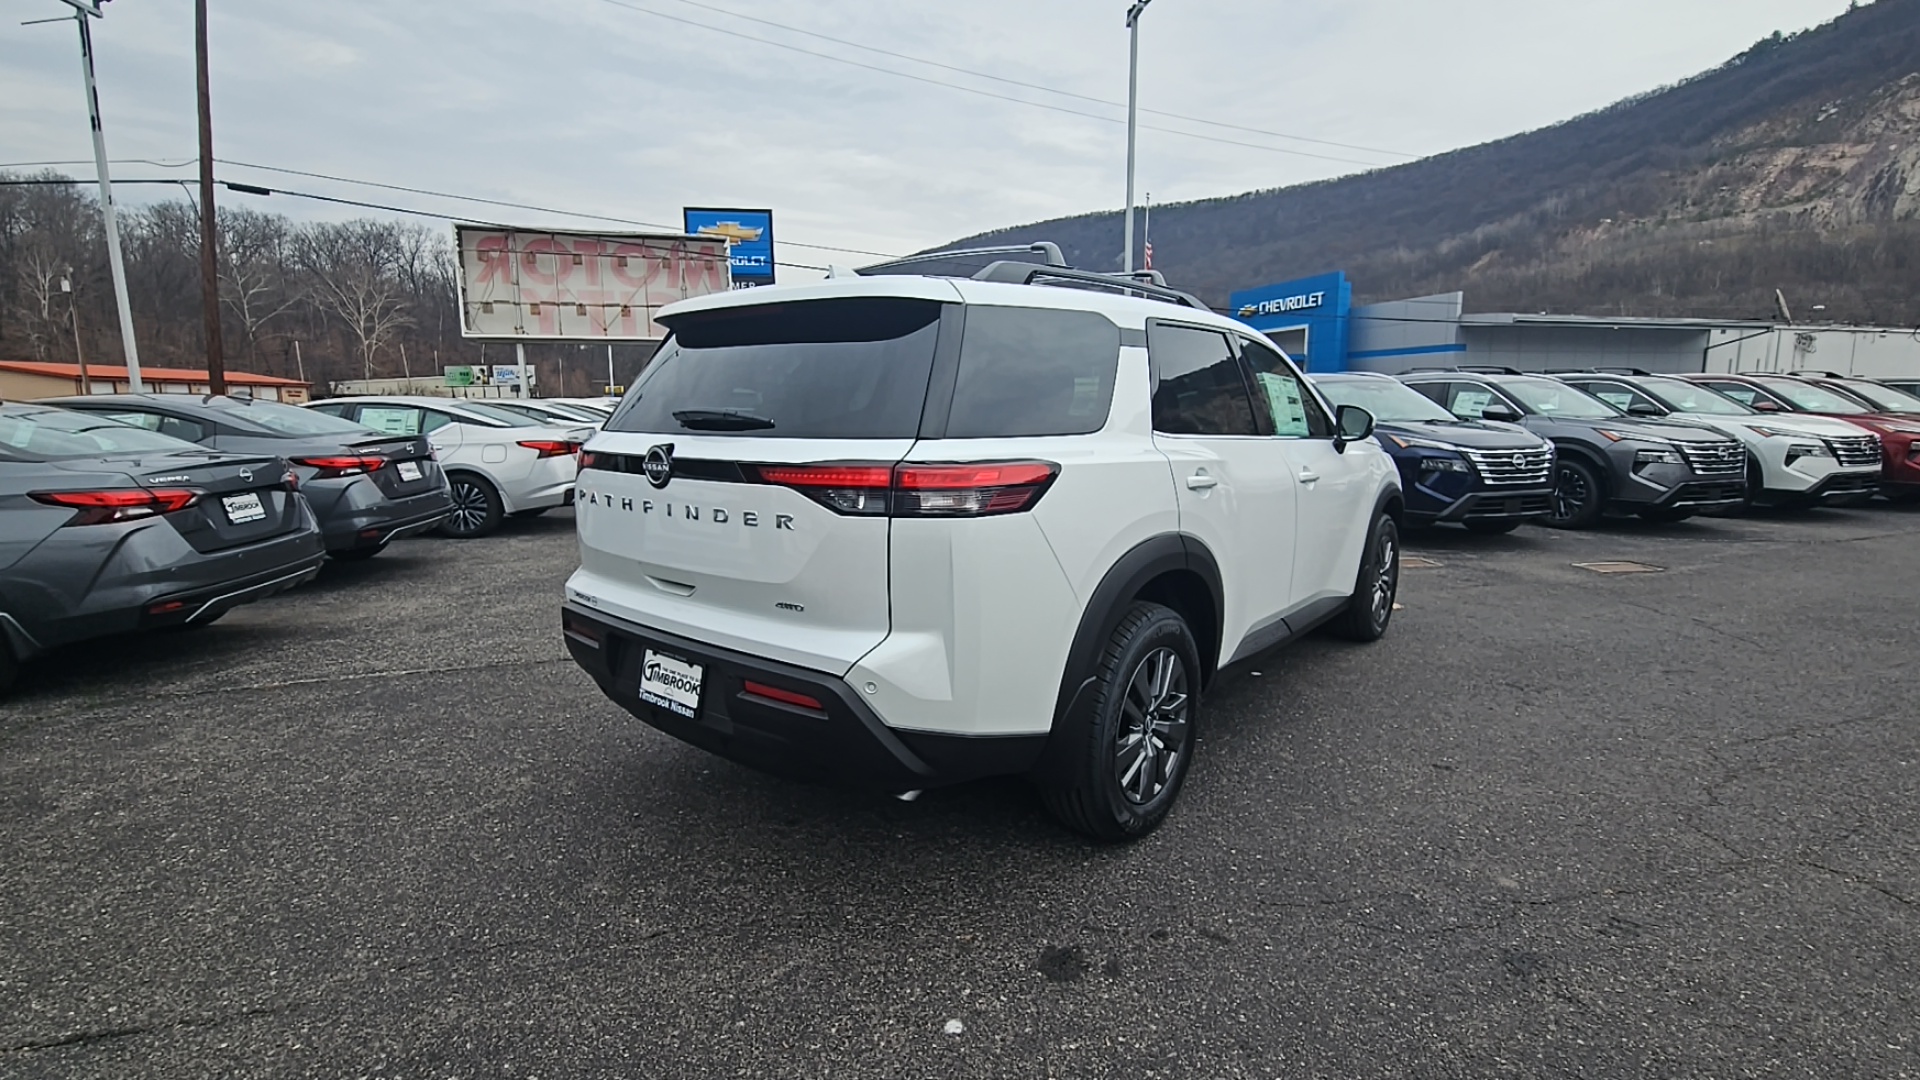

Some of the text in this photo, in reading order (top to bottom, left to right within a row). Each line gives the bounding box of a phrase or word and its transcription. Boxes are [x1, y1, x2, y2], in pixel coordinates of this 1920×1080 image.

[1259, 291, 1325, 315] CHEVROLET
[642, 462, 670, 472] NISSAN
[579, 489, 795, 531] PATHFINDER
[775, 602, 804, 612] 4WD
[643, 660, 701, 695] TIMBROOK
[639, 688, 694, 718] Timbrook Nissan
